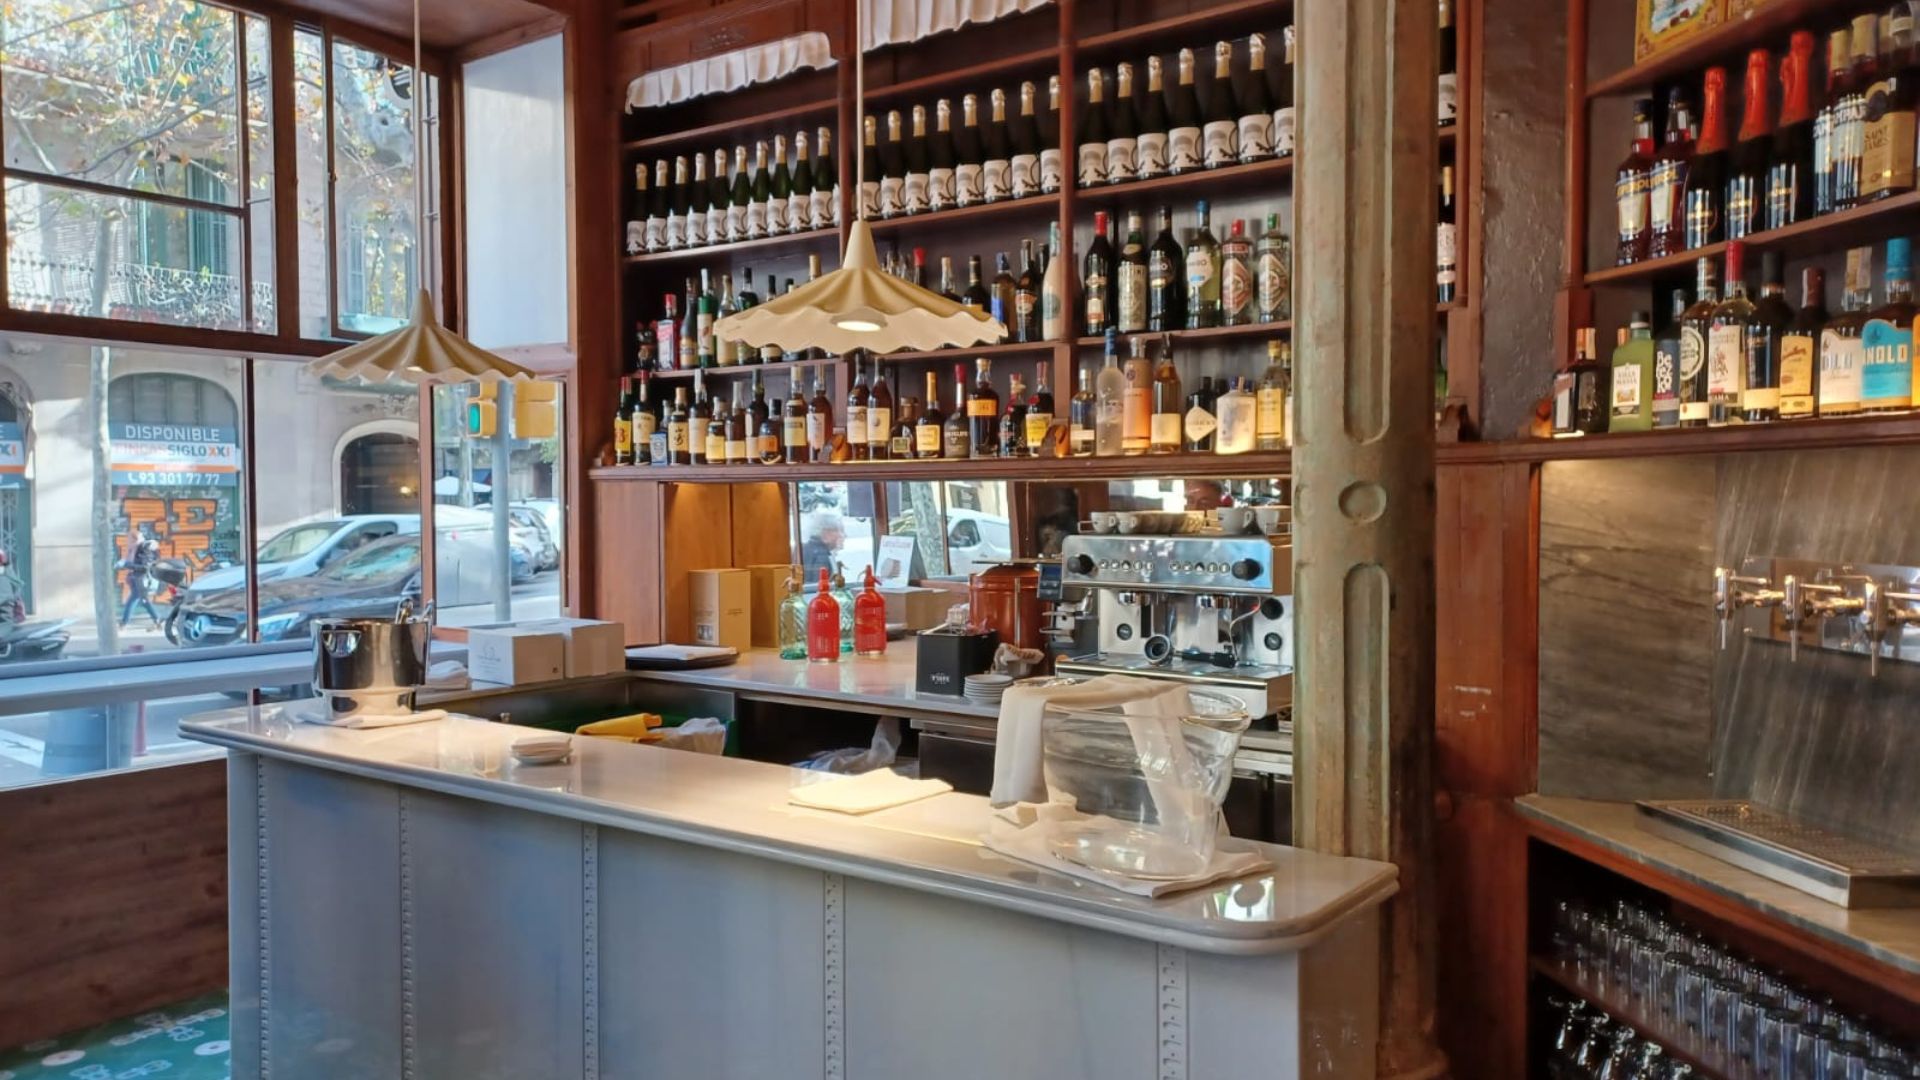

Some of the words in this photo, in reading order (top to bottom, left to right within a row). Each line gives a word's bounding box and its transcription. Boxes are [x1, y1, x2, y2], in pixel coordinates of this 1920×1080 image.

[125, 424, 220, 442] DISPONIBLE
[138, 472, 156, 485] 93
[159, 472, 183, 485] 301
[186, 472, 203, 485] 77
[205, 473, 220, 486] 77
